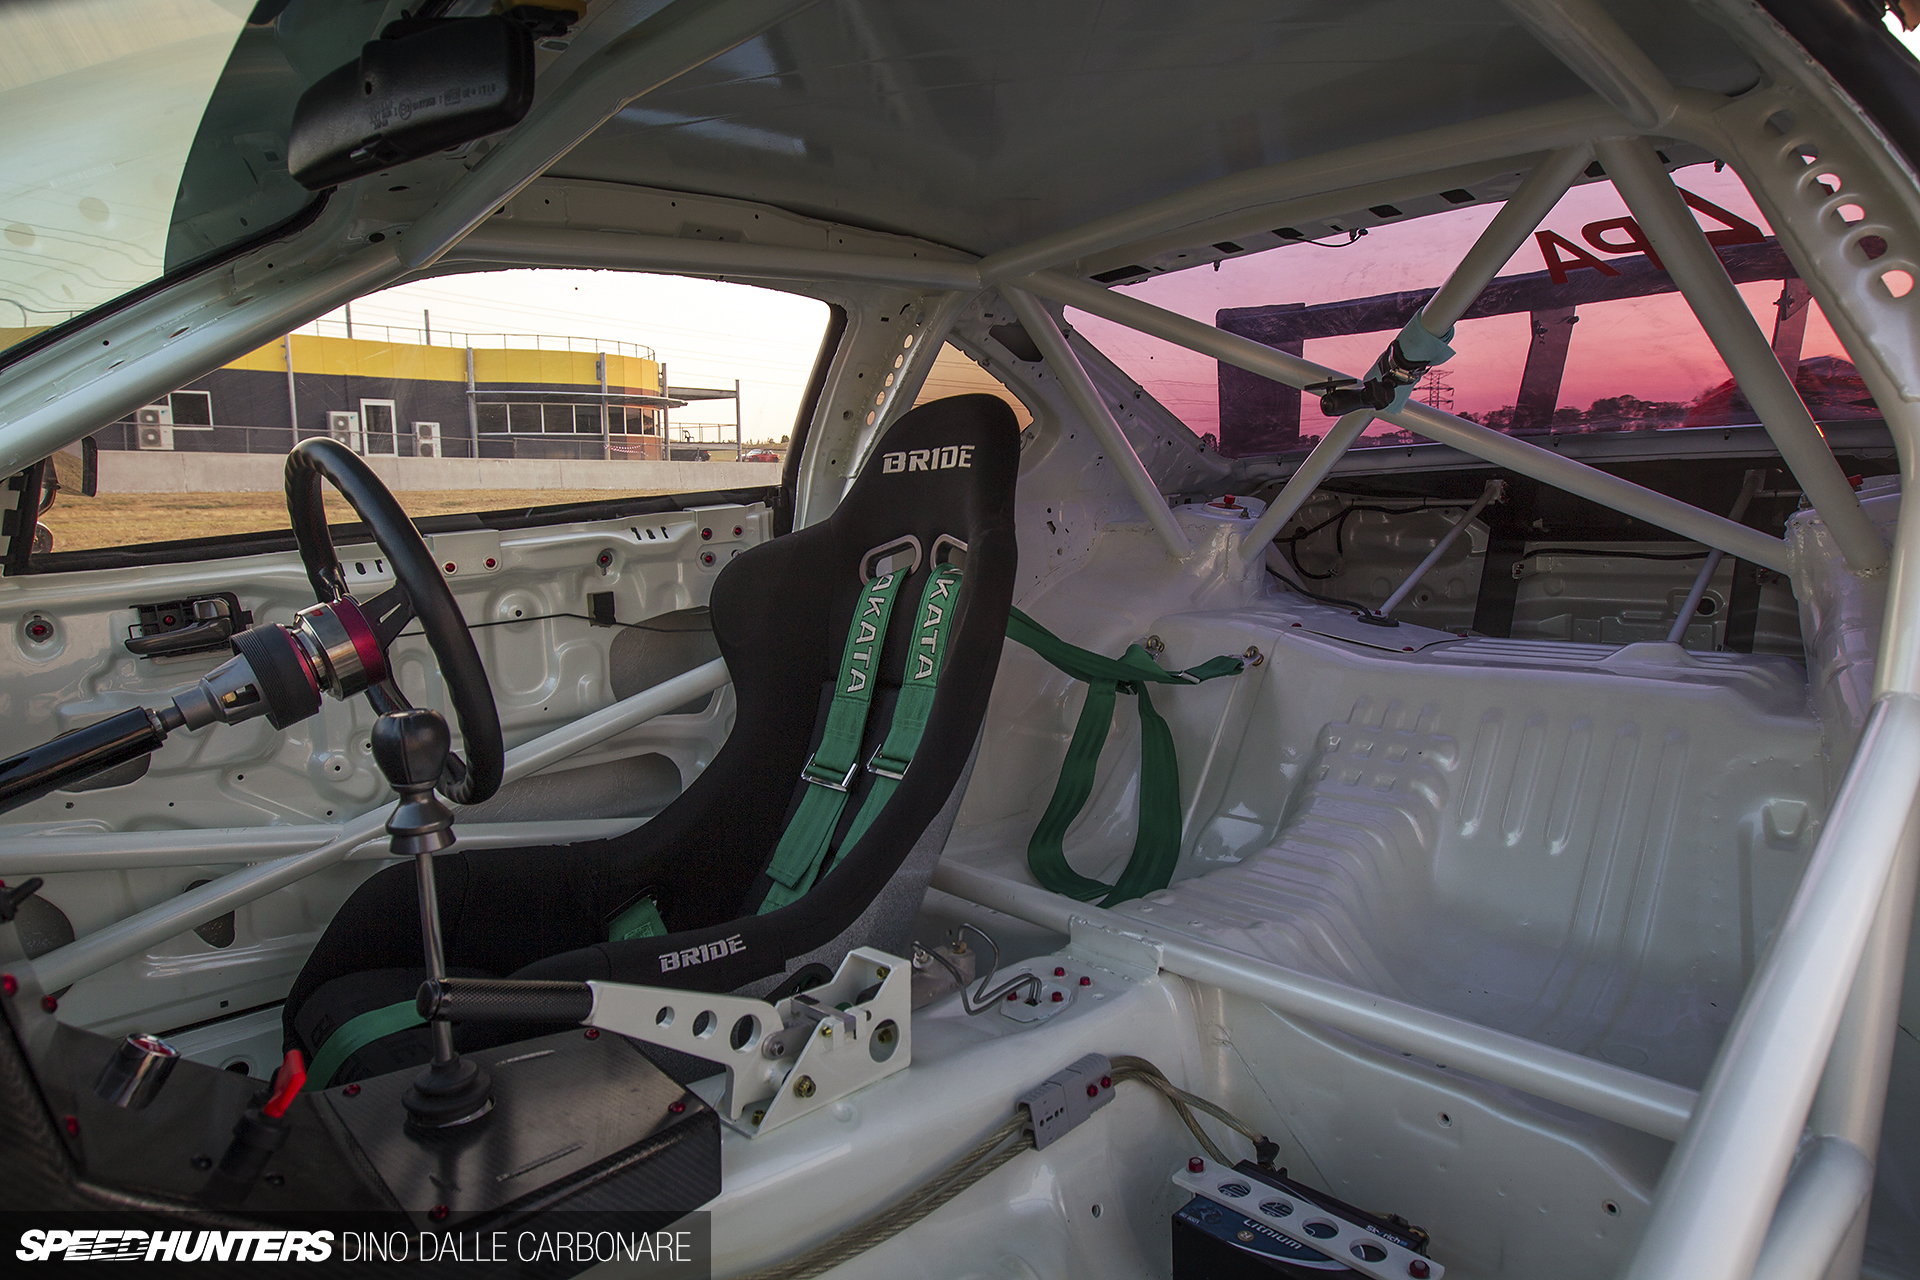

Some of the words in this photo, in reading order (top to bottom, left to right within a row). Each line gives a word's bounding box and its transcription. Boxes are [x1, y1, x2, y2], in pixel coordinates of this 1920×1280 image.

[882, 445, 976, 474] BRIDE
[914, 567, 963, 680] KATA
[658, 933, 747, 973] BRIDE
